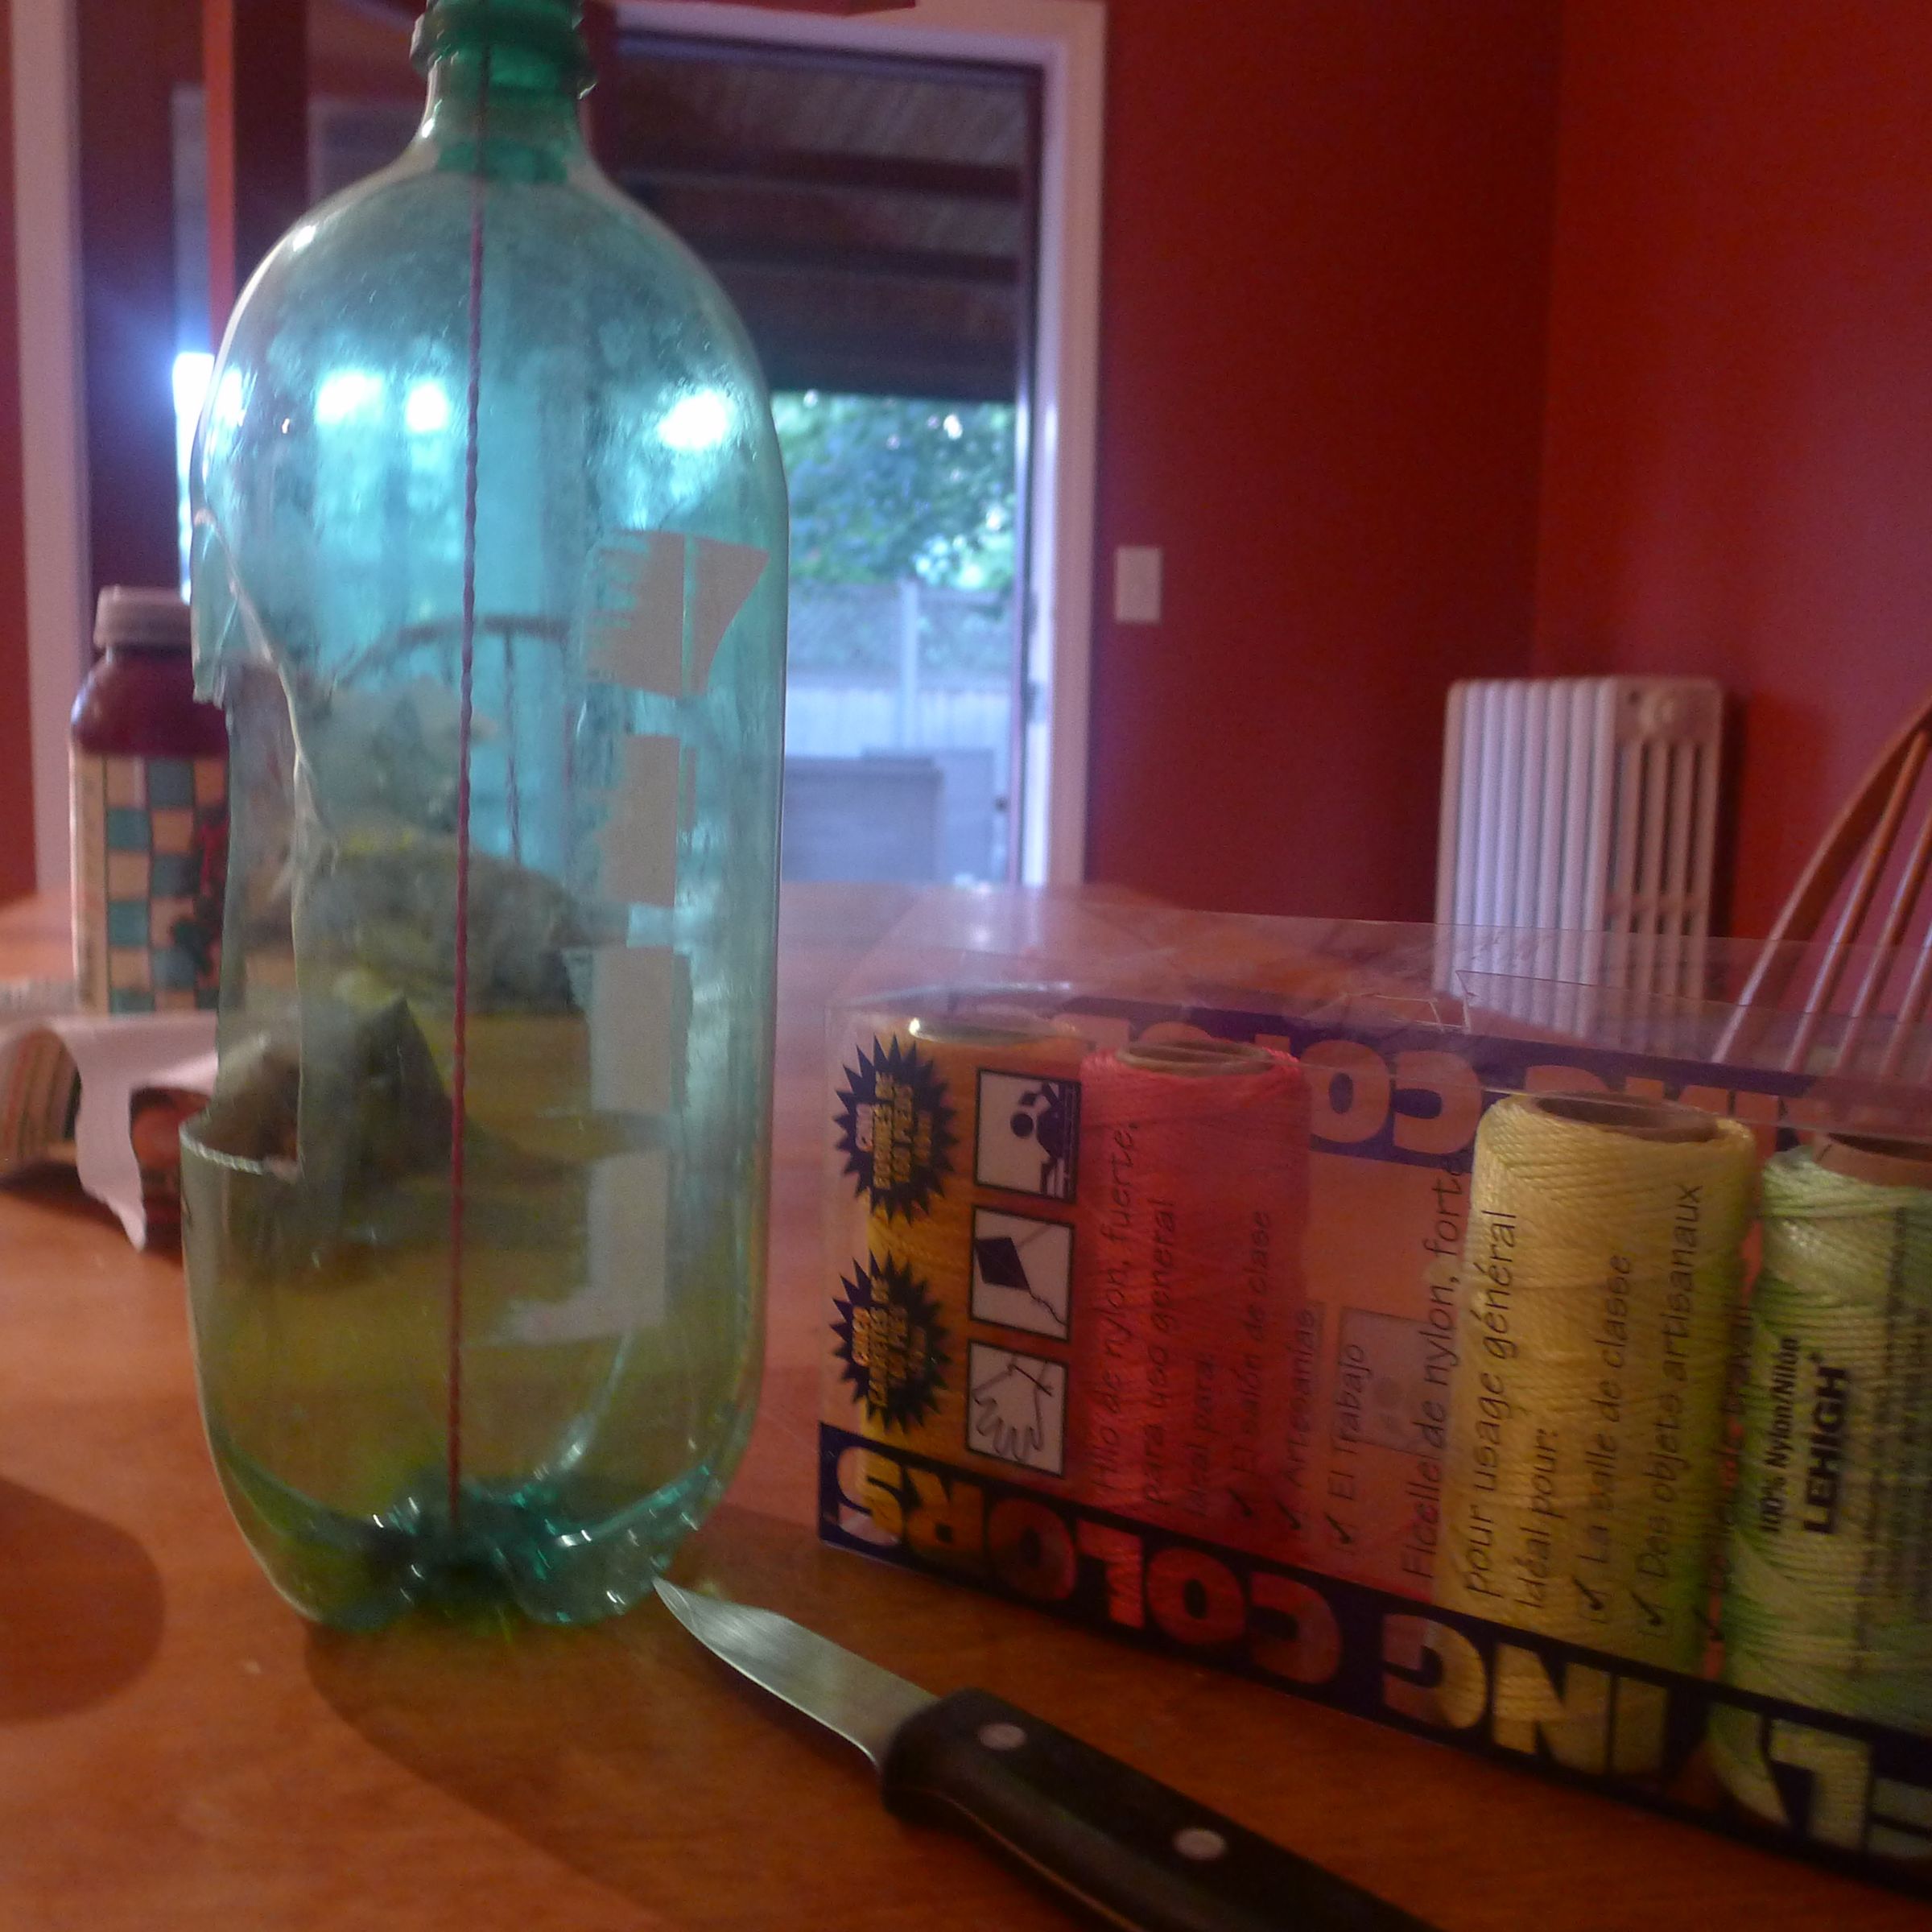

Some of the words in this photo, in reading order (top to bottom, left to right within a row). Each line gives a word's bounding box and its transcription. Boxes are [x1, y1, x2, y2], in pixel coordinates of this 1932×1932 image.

[1096, 1122, 1138, 1241] fuerte,
[1150, 1199, 1179, 1332] general
[1245, 1211, 1272, 1295] clase
[1468, 1209, 1517, 1360] général
[1657, 1184, 1702, 1382] artisanaux
[1093, 1261, 1133, 1357] nylon,
[1241, 1303, 1265, 1343] de
[1418, 1276, 1460, 1387] nylon,
[1592, 1254, 1631, 1368] classe
[1094, 1374, 1122, 1414] de
[1146, 1348, 1170, 1408] uso
[1332, 1344, 1372, 1455] Trabajo
[1592, 1380, 1623, 1423] de
[1090, 1428, 1119, 1492] Hilo
[1141, 1424, 1170, 1505] para
[1410, 1402, 1447, 1448] de
[1470, 1372, 1510, 1492] usage
[1640, 1393, 1690, 1503] objets
[1803, 1366, 1846, 1534] LEHIGH
[1327, 1472, 1356, 1501] El
[1401, 1455, 1442, 1579] Ficelle
[1530, 1428, 1565, 1519] pour:
[1584, 1433, 1618, 1512] salle
[836, 1446, 1344, 1684] COLORS
[1461, 1505, 1503, 1598] pour
[1512, 1527, 1551, 1609] Idéal
[1576, 1526, 1610, 1564] La
[1635, 1516, 1670, 1579] Des
